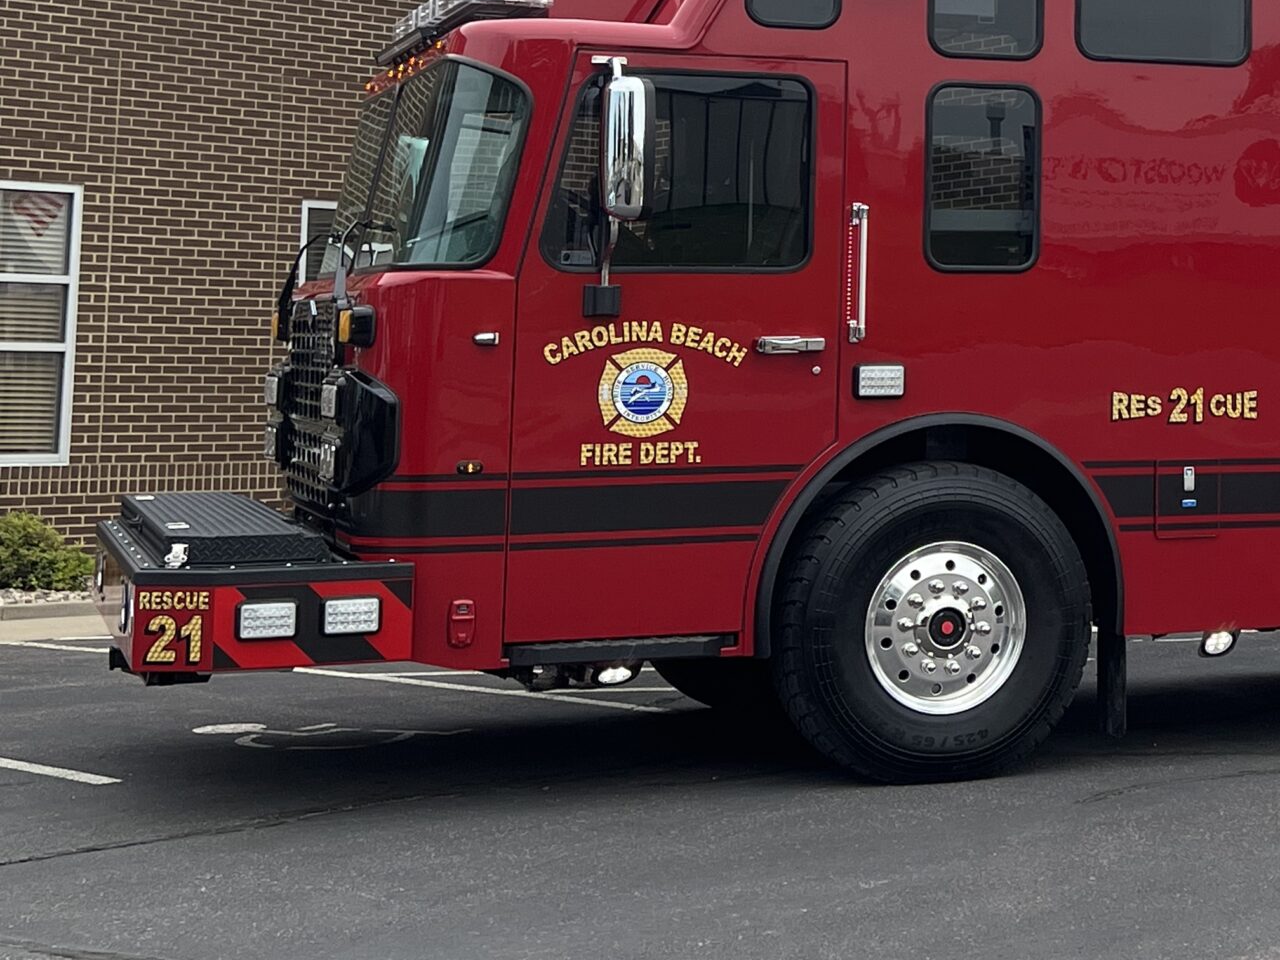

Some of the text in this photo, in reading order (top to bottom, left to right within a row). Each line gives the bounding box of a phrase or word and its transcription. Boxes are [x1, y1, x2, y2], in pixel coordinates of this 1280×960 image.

[543, 321, 748, 367] CAROLINA BEACH
[1112, 387, 1258, 423] RES 21 CUE
[580, 441, 701, 466] FIRE DEPT.
[139, 591, 209, 611] RESCUE
[145, 615, 203, 664] 21
